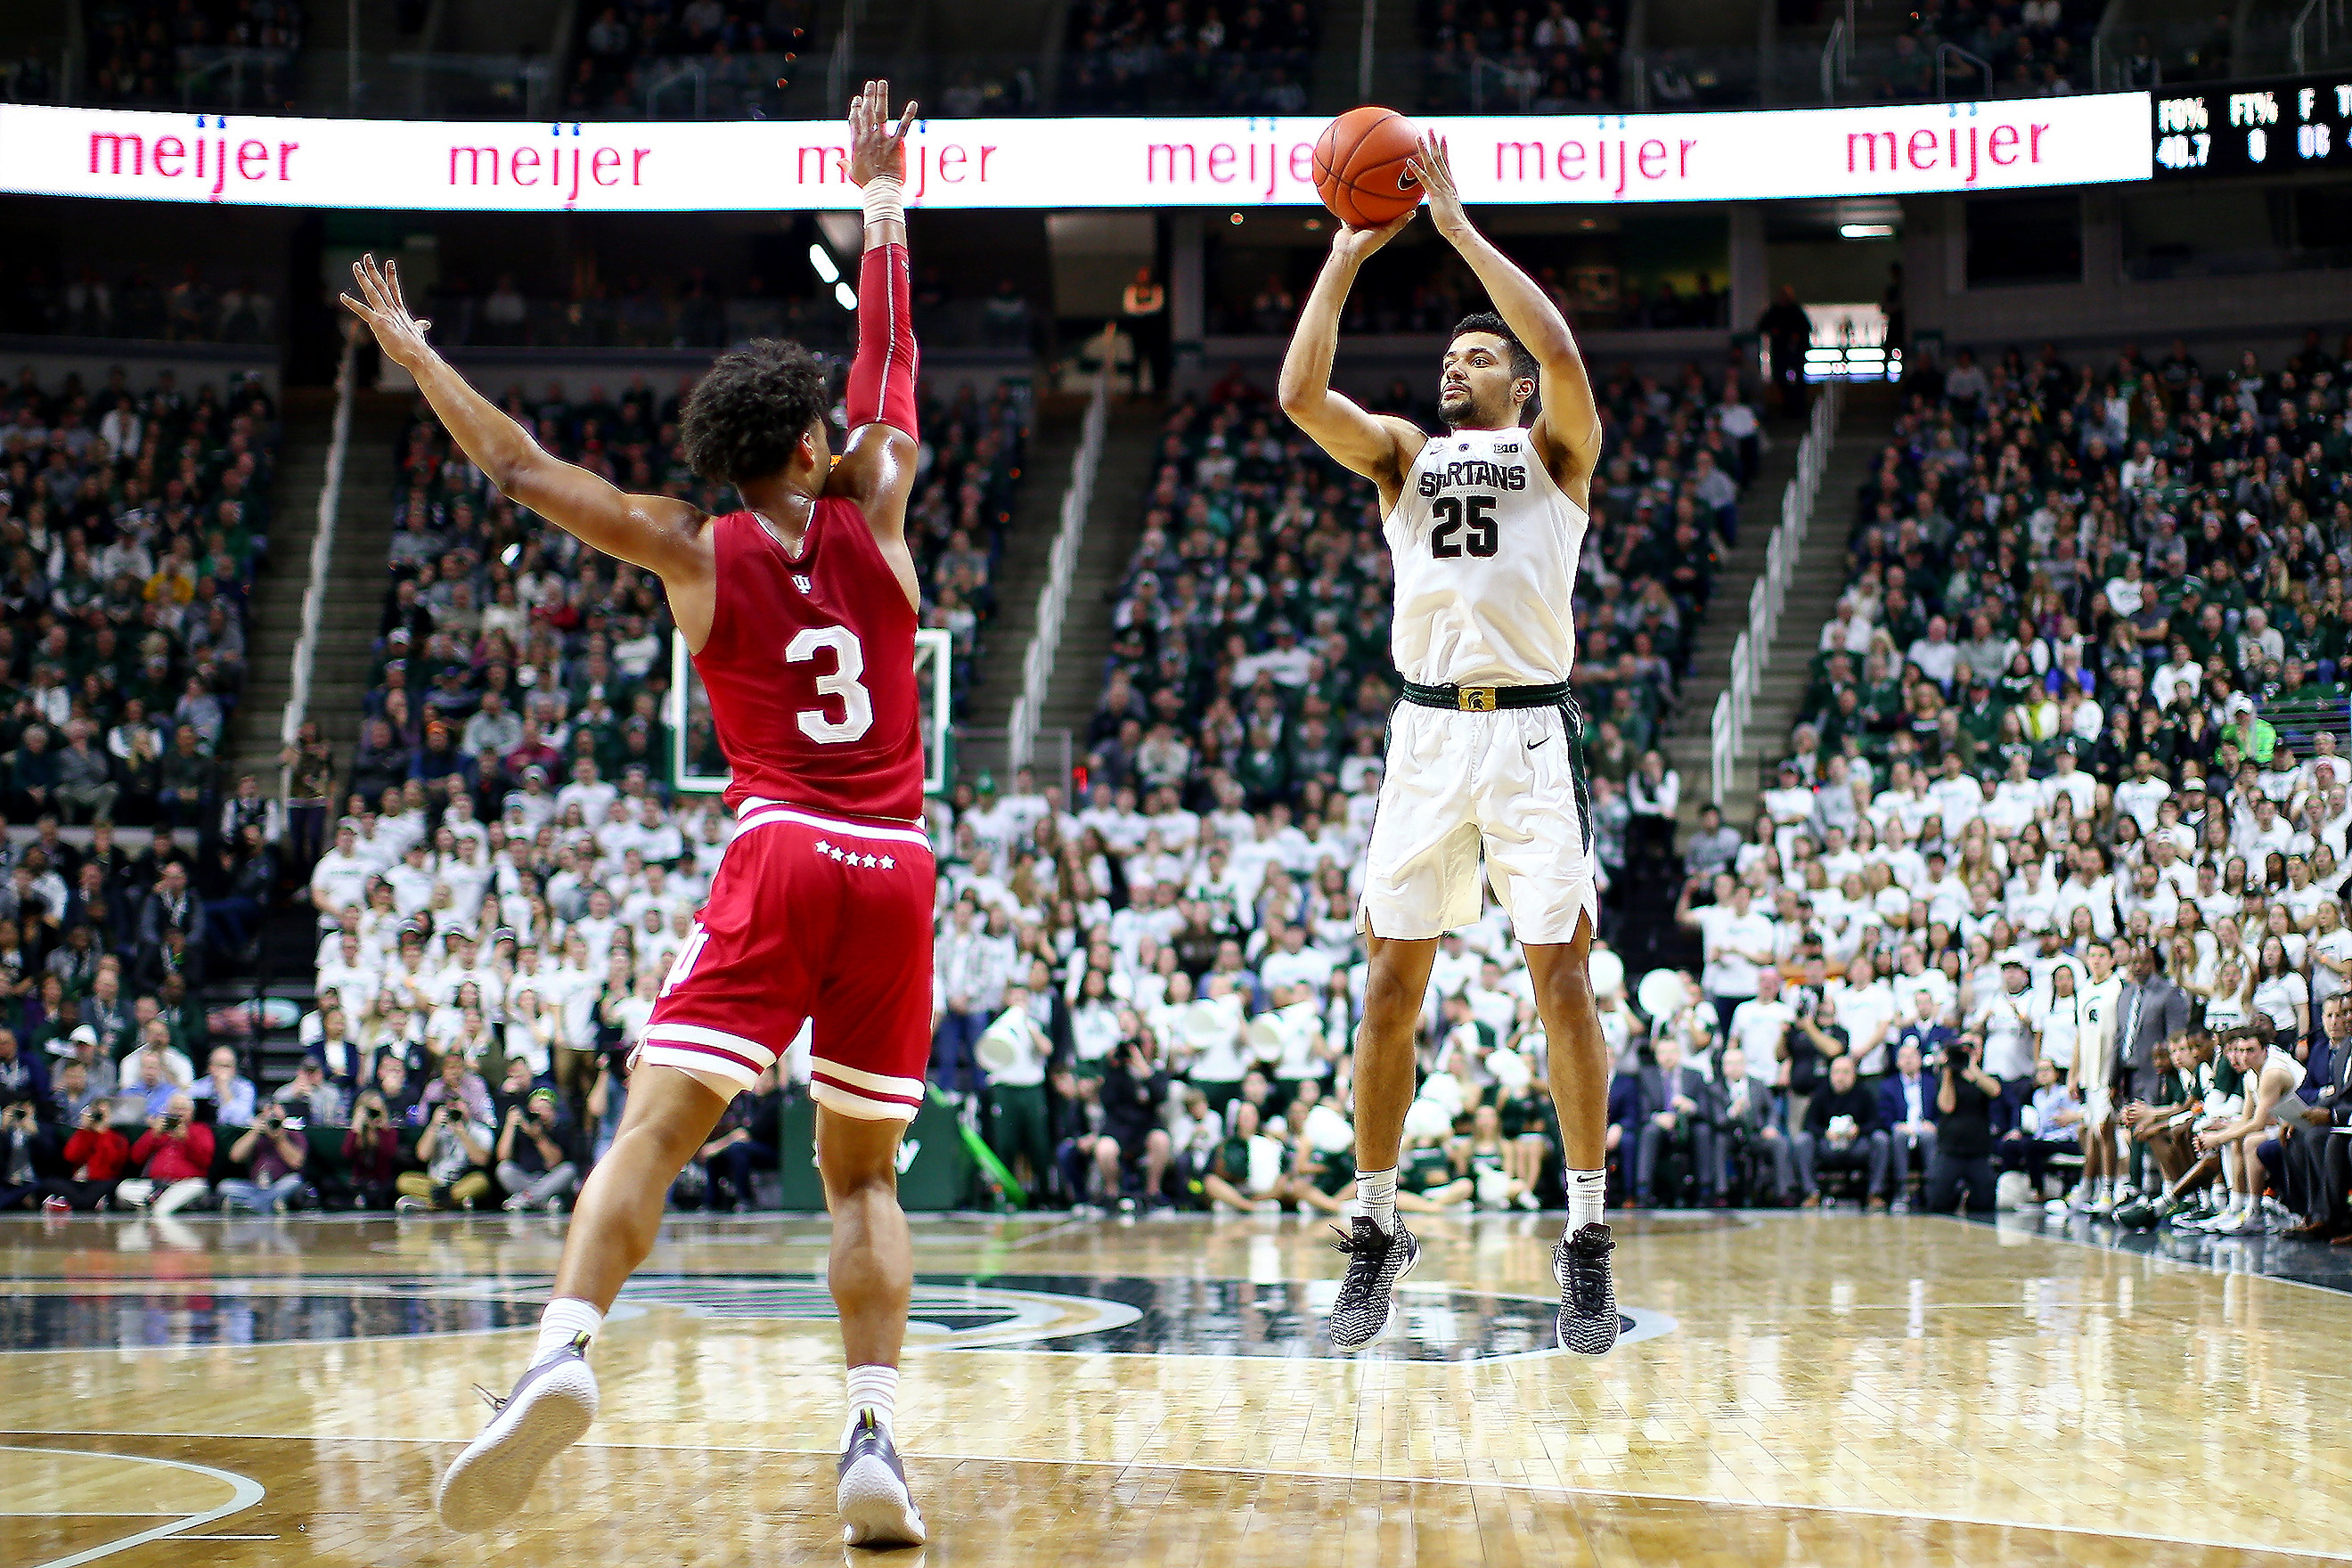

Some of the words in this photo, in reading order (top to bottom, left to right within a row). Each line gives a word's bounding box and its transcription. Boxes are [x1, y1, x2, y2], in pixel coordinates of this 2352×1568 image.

[88, 115, 299, 201] meijer
[449, 123, 650, 208] meijer
[798, 120, 997, 206] mjer
[1147, 118, 1315, 202] meije
[1496, 115, 1697, 199] meijer
[1847, 102, 2050, 188] meijer
[1418, 461, 1527, 498] SPRTANS
[1431, 495, 1499, 559] 25
[785, 625, 874, 745] 3
